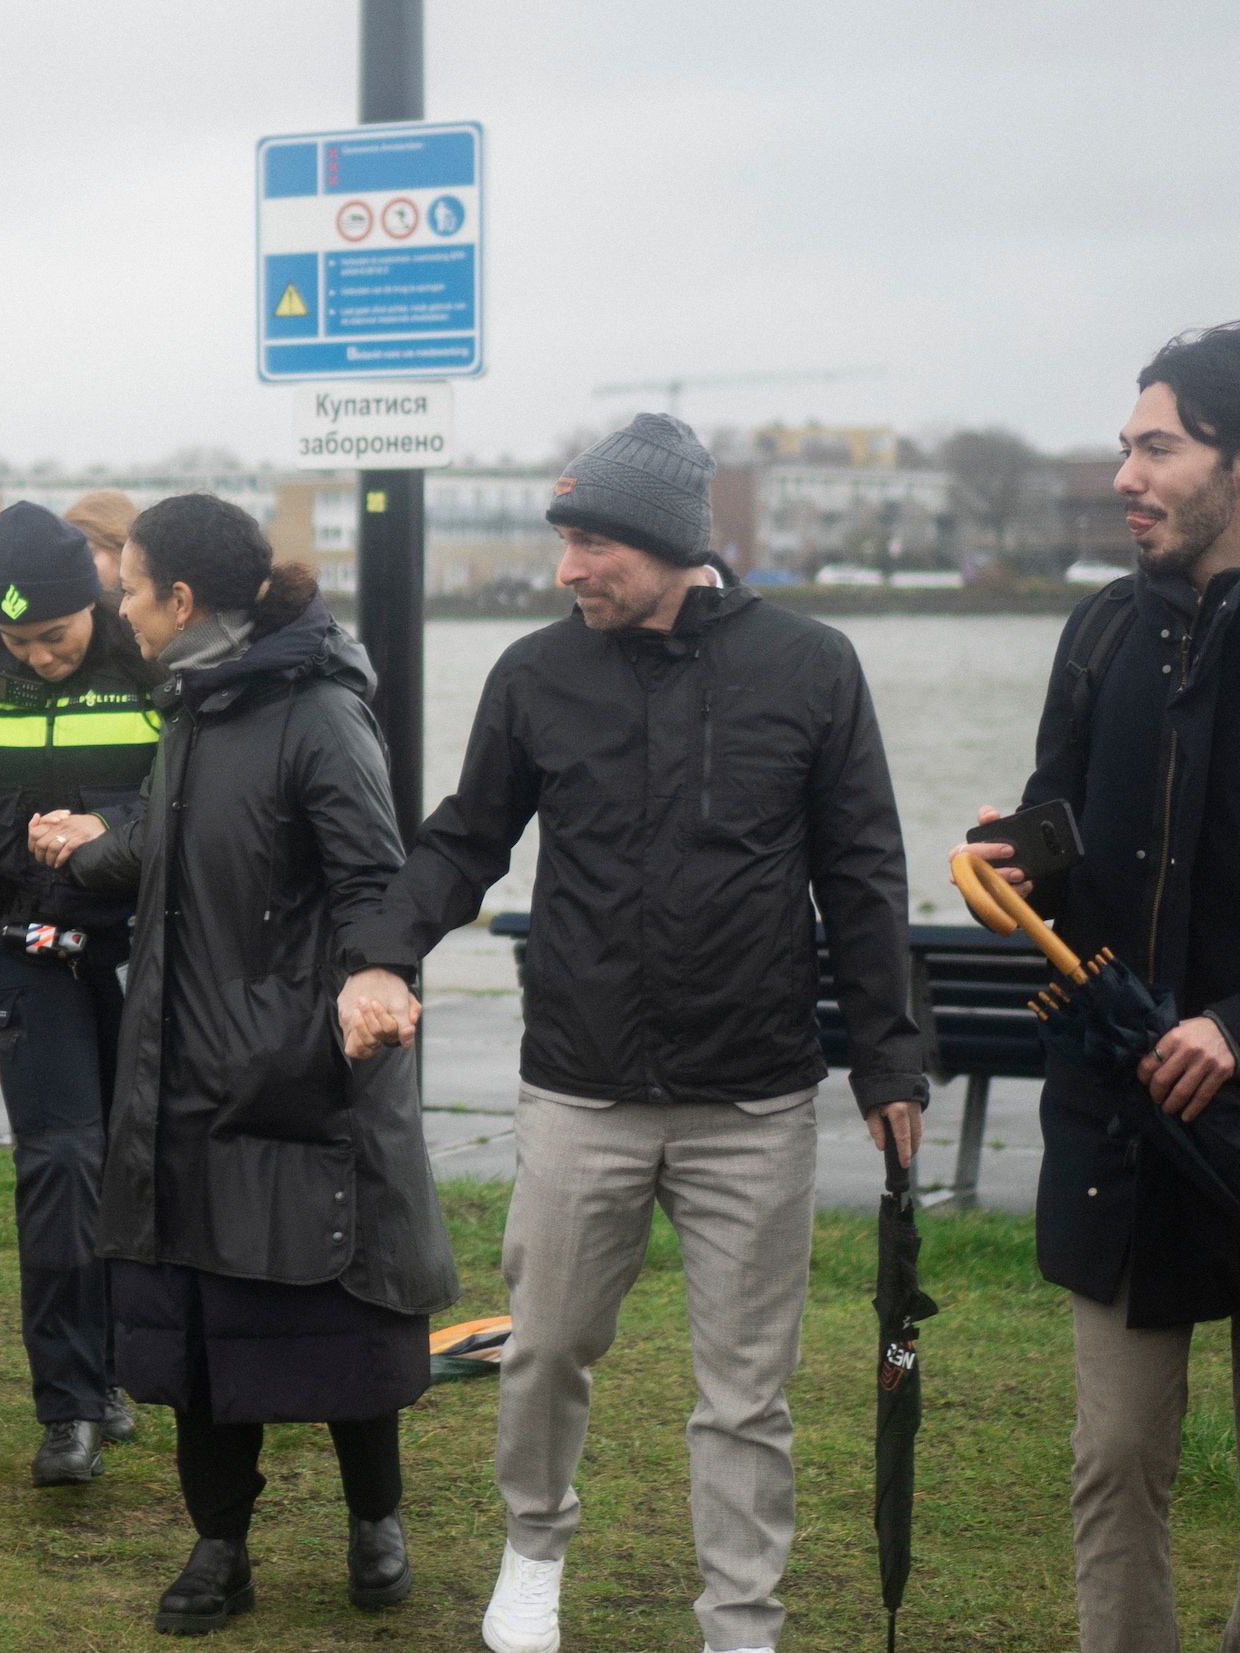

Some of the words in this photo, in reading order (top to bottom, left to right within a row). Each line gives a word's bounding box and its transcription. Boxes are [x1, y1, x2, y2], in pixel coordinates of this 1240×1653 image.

[316, 393, 427, 422] Купатися
[300, 430, 444, 460] заборонено
[79, 690, 128, 707] POLITIE
